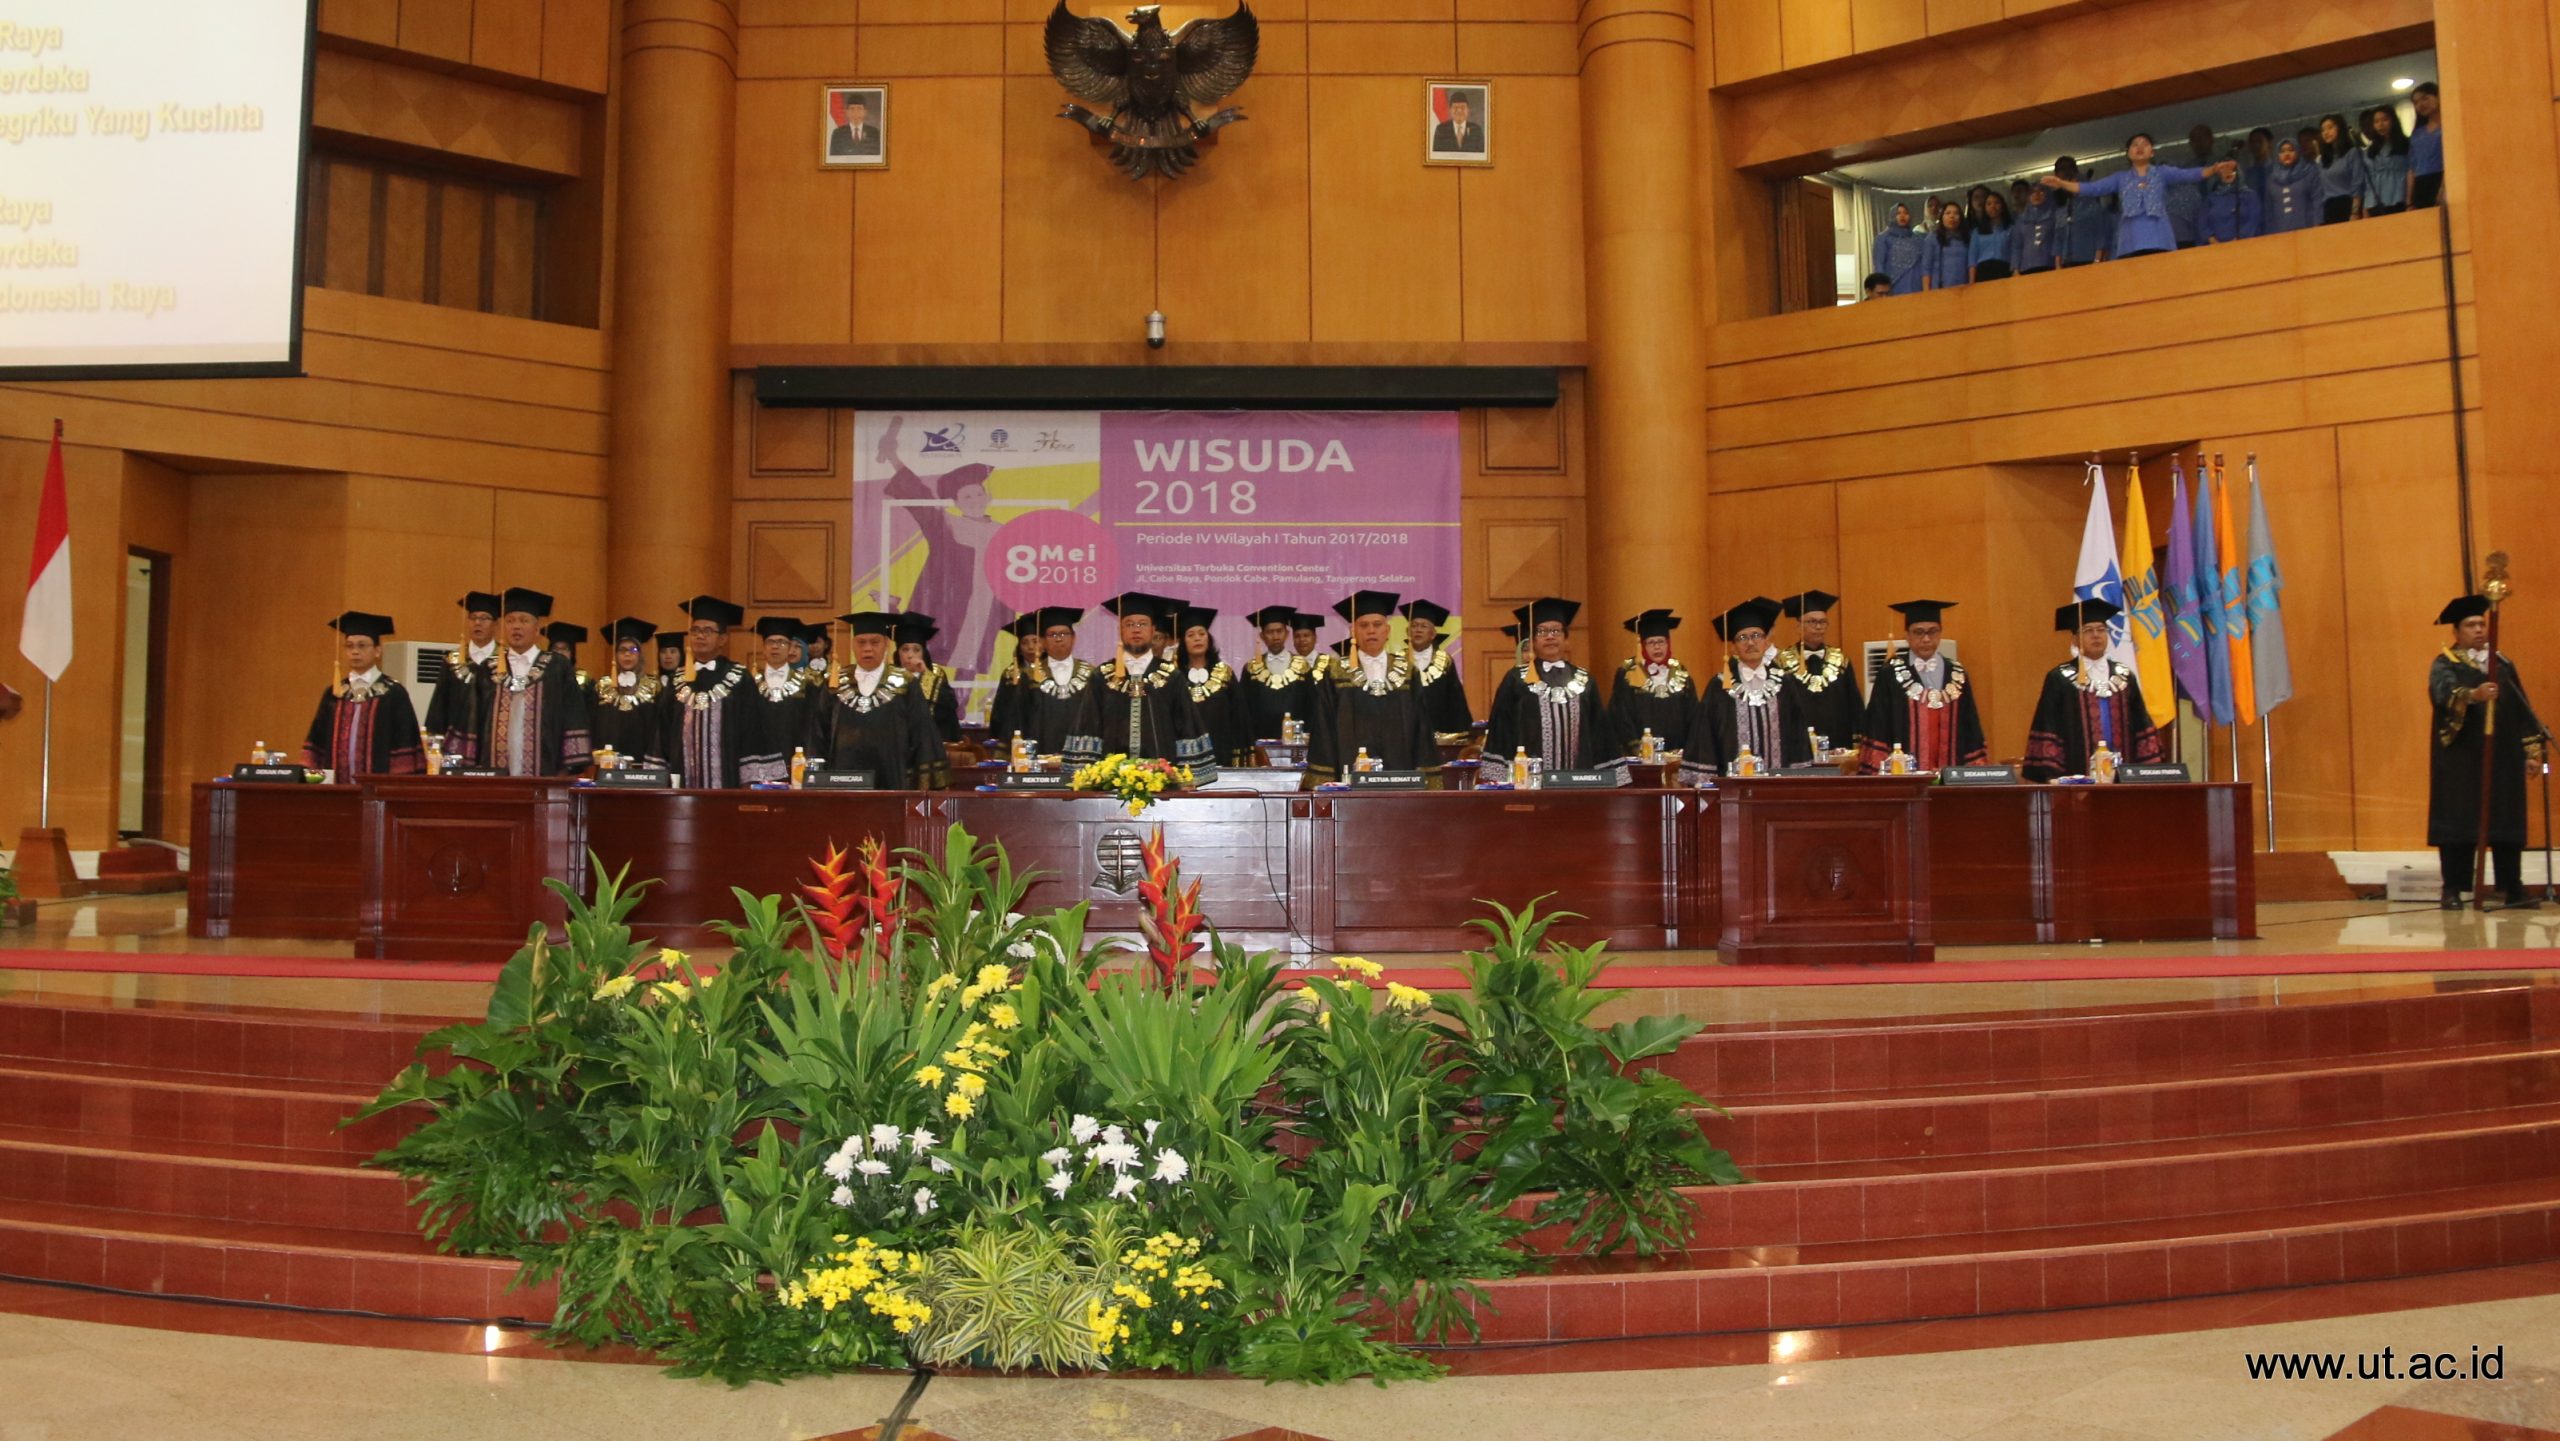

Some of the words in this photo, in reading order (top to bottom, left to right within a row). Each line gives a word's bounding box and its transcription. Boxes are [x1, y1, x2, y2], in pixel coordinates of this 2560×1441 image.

[85, 105, 151, 140] Yang
[157, 101, 264, 133] Kucinta
[108, 277, 178, 319] Raya
[1134, 439, 1355, 472] WISUDA
[1135, 480, 1257, 514] 2018
[1136, 532, 1193, 545] Periode
[1197, 533, 1211, 544] IV
[1214, 532, 1271, 547] Wilayah
[1282, 533, 1326, 544] Tahun
[1329, 532, 1409, 547] 2017/2018
[1005, 544, 1038, 584] 8
[1040, 543, 1097, 562] Mei
[1039, 566, 1097, 584] 2018
[1136, 563, 1192, 573] Universitas
[1194, 564, 1234, 572] Terbuka
[1236, 563, 1293, 573] Convention
[1295, 564, 1329, 572] Center
[1204, 574, 1241, 583] Pondok
[1325, 574, 1377, 584] Tangerang
[1379, 574, 1416, 583] Selatan
